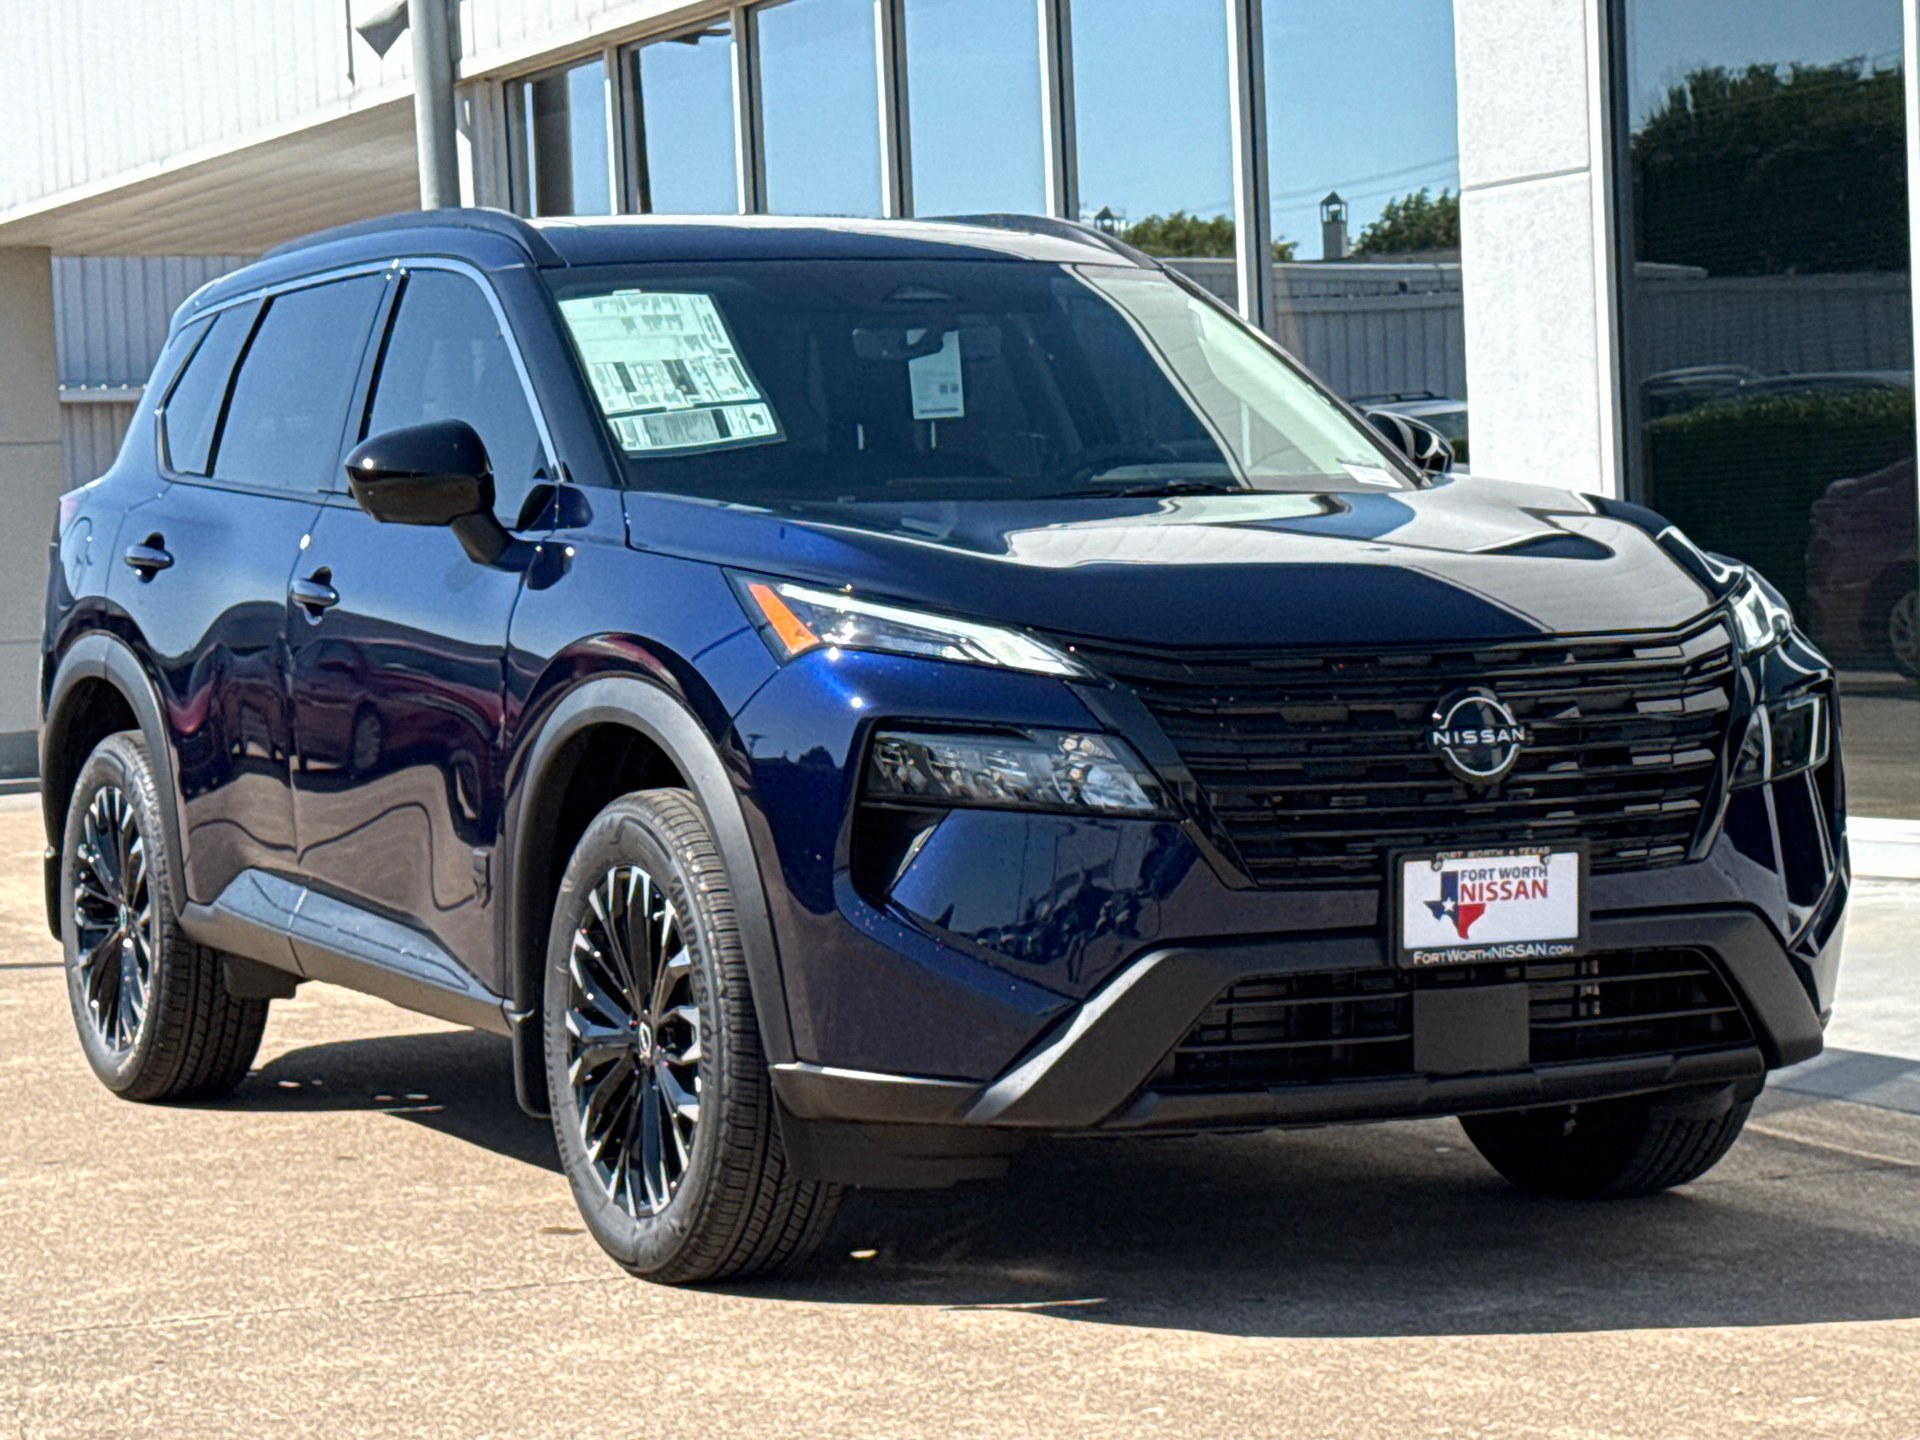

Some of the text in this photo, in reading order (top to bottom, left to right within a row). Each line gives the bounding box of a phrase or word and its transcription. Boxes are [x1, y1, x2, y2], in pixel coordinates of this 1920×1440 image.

[1433, 726, 1525, 746] NISSAN
[1518, 845, 1551, 856] TEXAS
[1460, 865, 1549, 882] FORT WORTH
[1460, 879, 1549, 902] NISSAN
